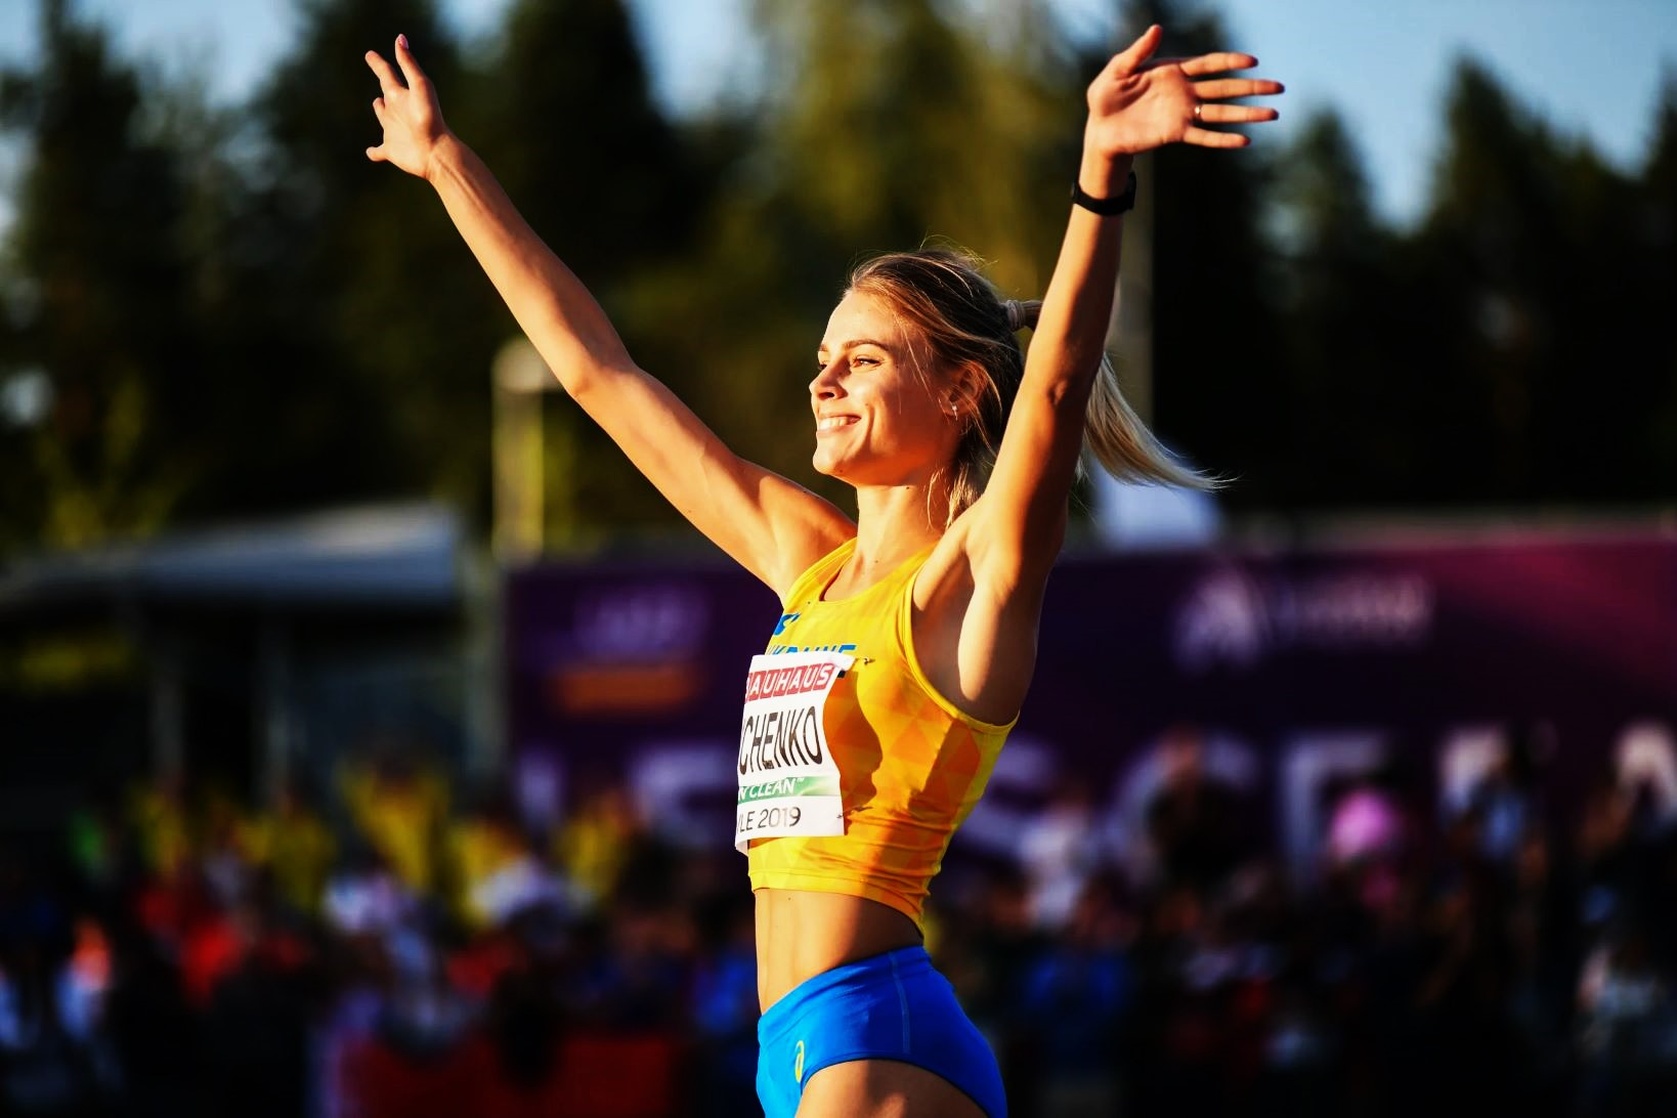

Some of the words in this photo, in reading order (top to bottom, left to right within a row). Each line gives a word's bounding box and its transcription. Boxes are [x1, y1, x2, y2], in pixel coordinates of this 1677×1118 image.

[747, 664, 833, 698] AUHAUS
[740, 705, 823, 775] CHENKO
[757, 806, 801, 828] 2019
